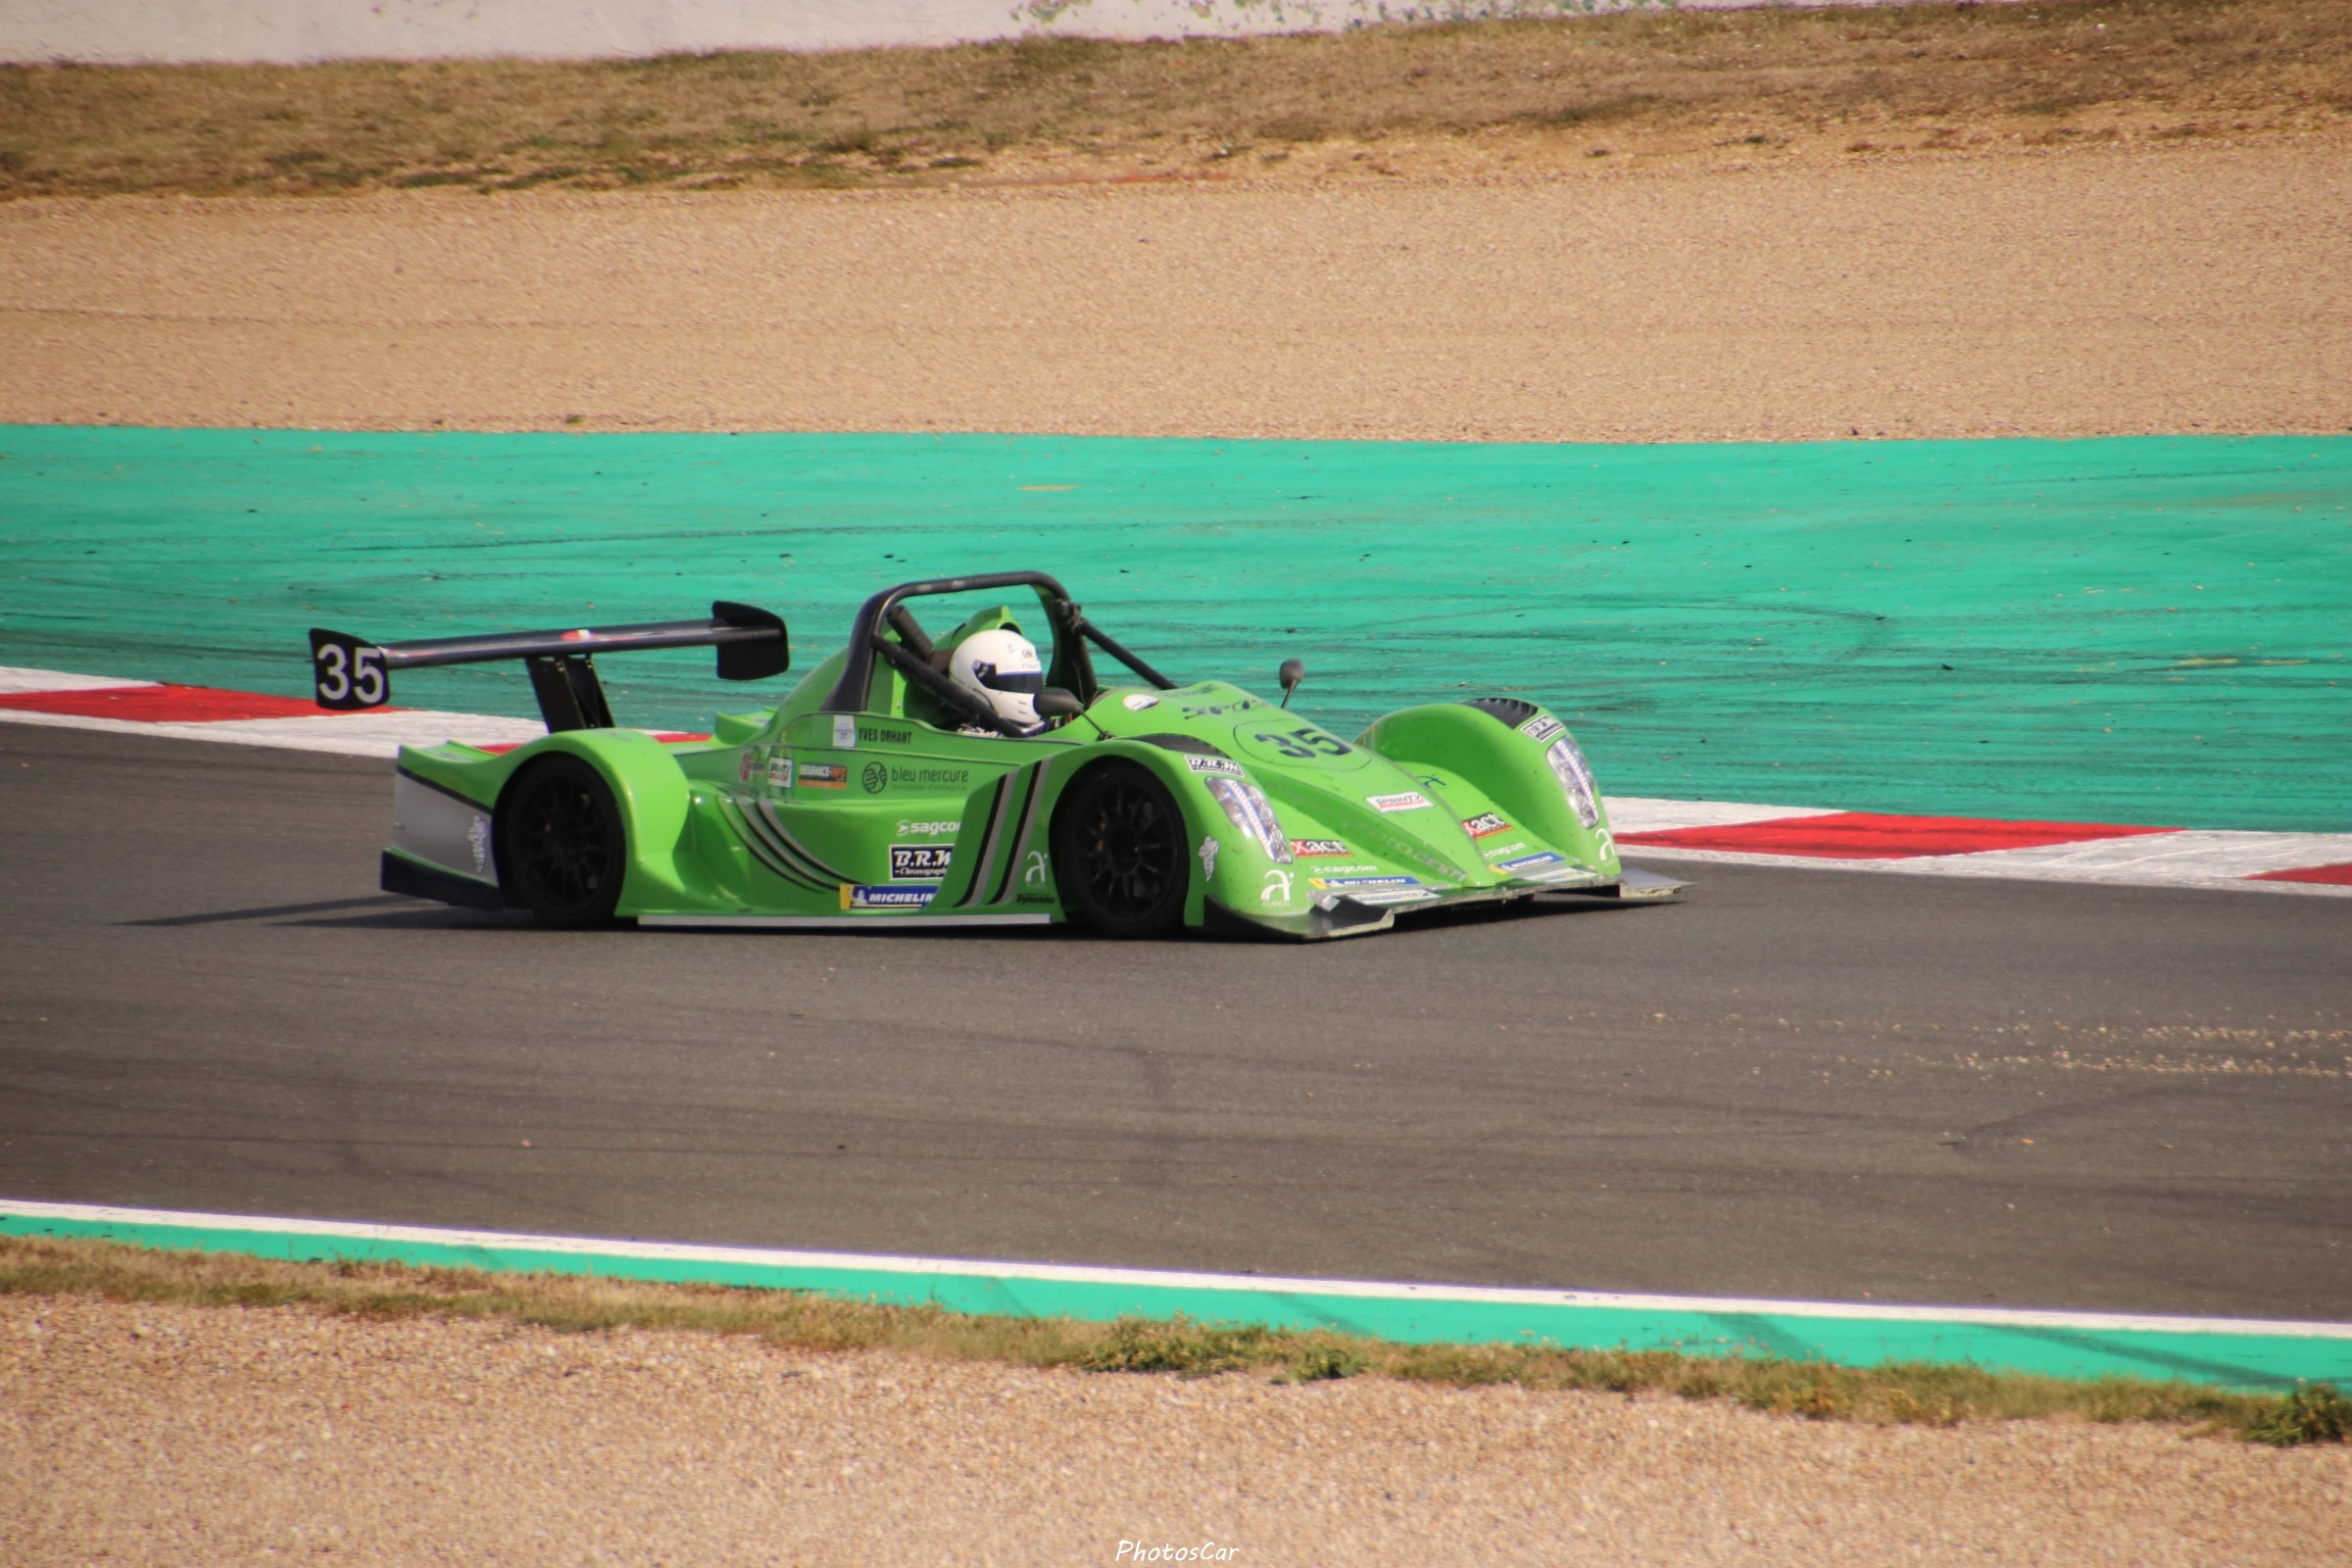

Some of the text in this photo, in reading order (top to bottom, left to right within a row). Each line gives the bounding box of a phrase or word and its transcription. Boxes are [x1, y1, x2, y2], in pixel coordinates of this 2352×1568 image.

[318, 643, 384, 704] 35
[859, 727, 878, 742] YVES
[1253, 727, 1352, 759] 35
[892, 765, 969, 783] bleu mercure
[910, 821, 961, 837] sagco
[868, 893, 936, 903] MICHELIN
